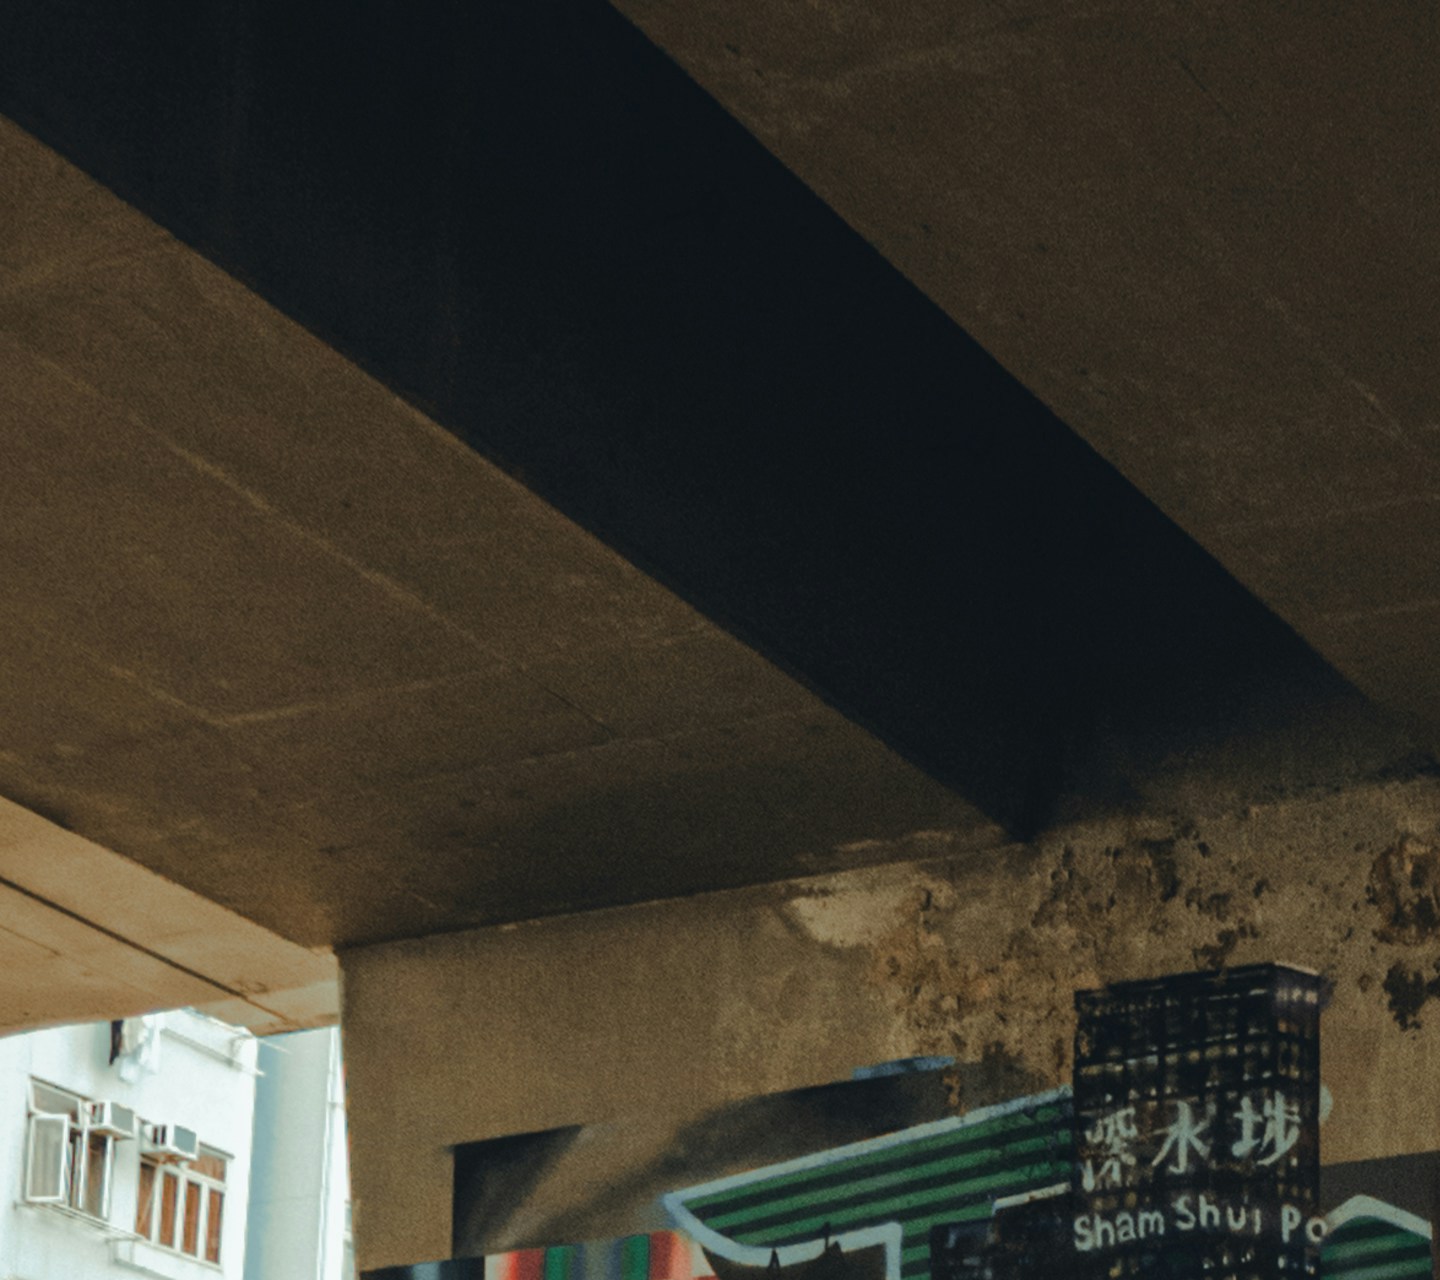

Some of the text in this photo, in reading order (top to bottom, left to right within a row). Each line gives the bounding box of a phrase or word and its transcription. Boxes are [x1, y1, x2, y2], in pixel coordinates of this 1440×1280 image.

[1073, 1195, 1328, 1252] Sham Shui Po
